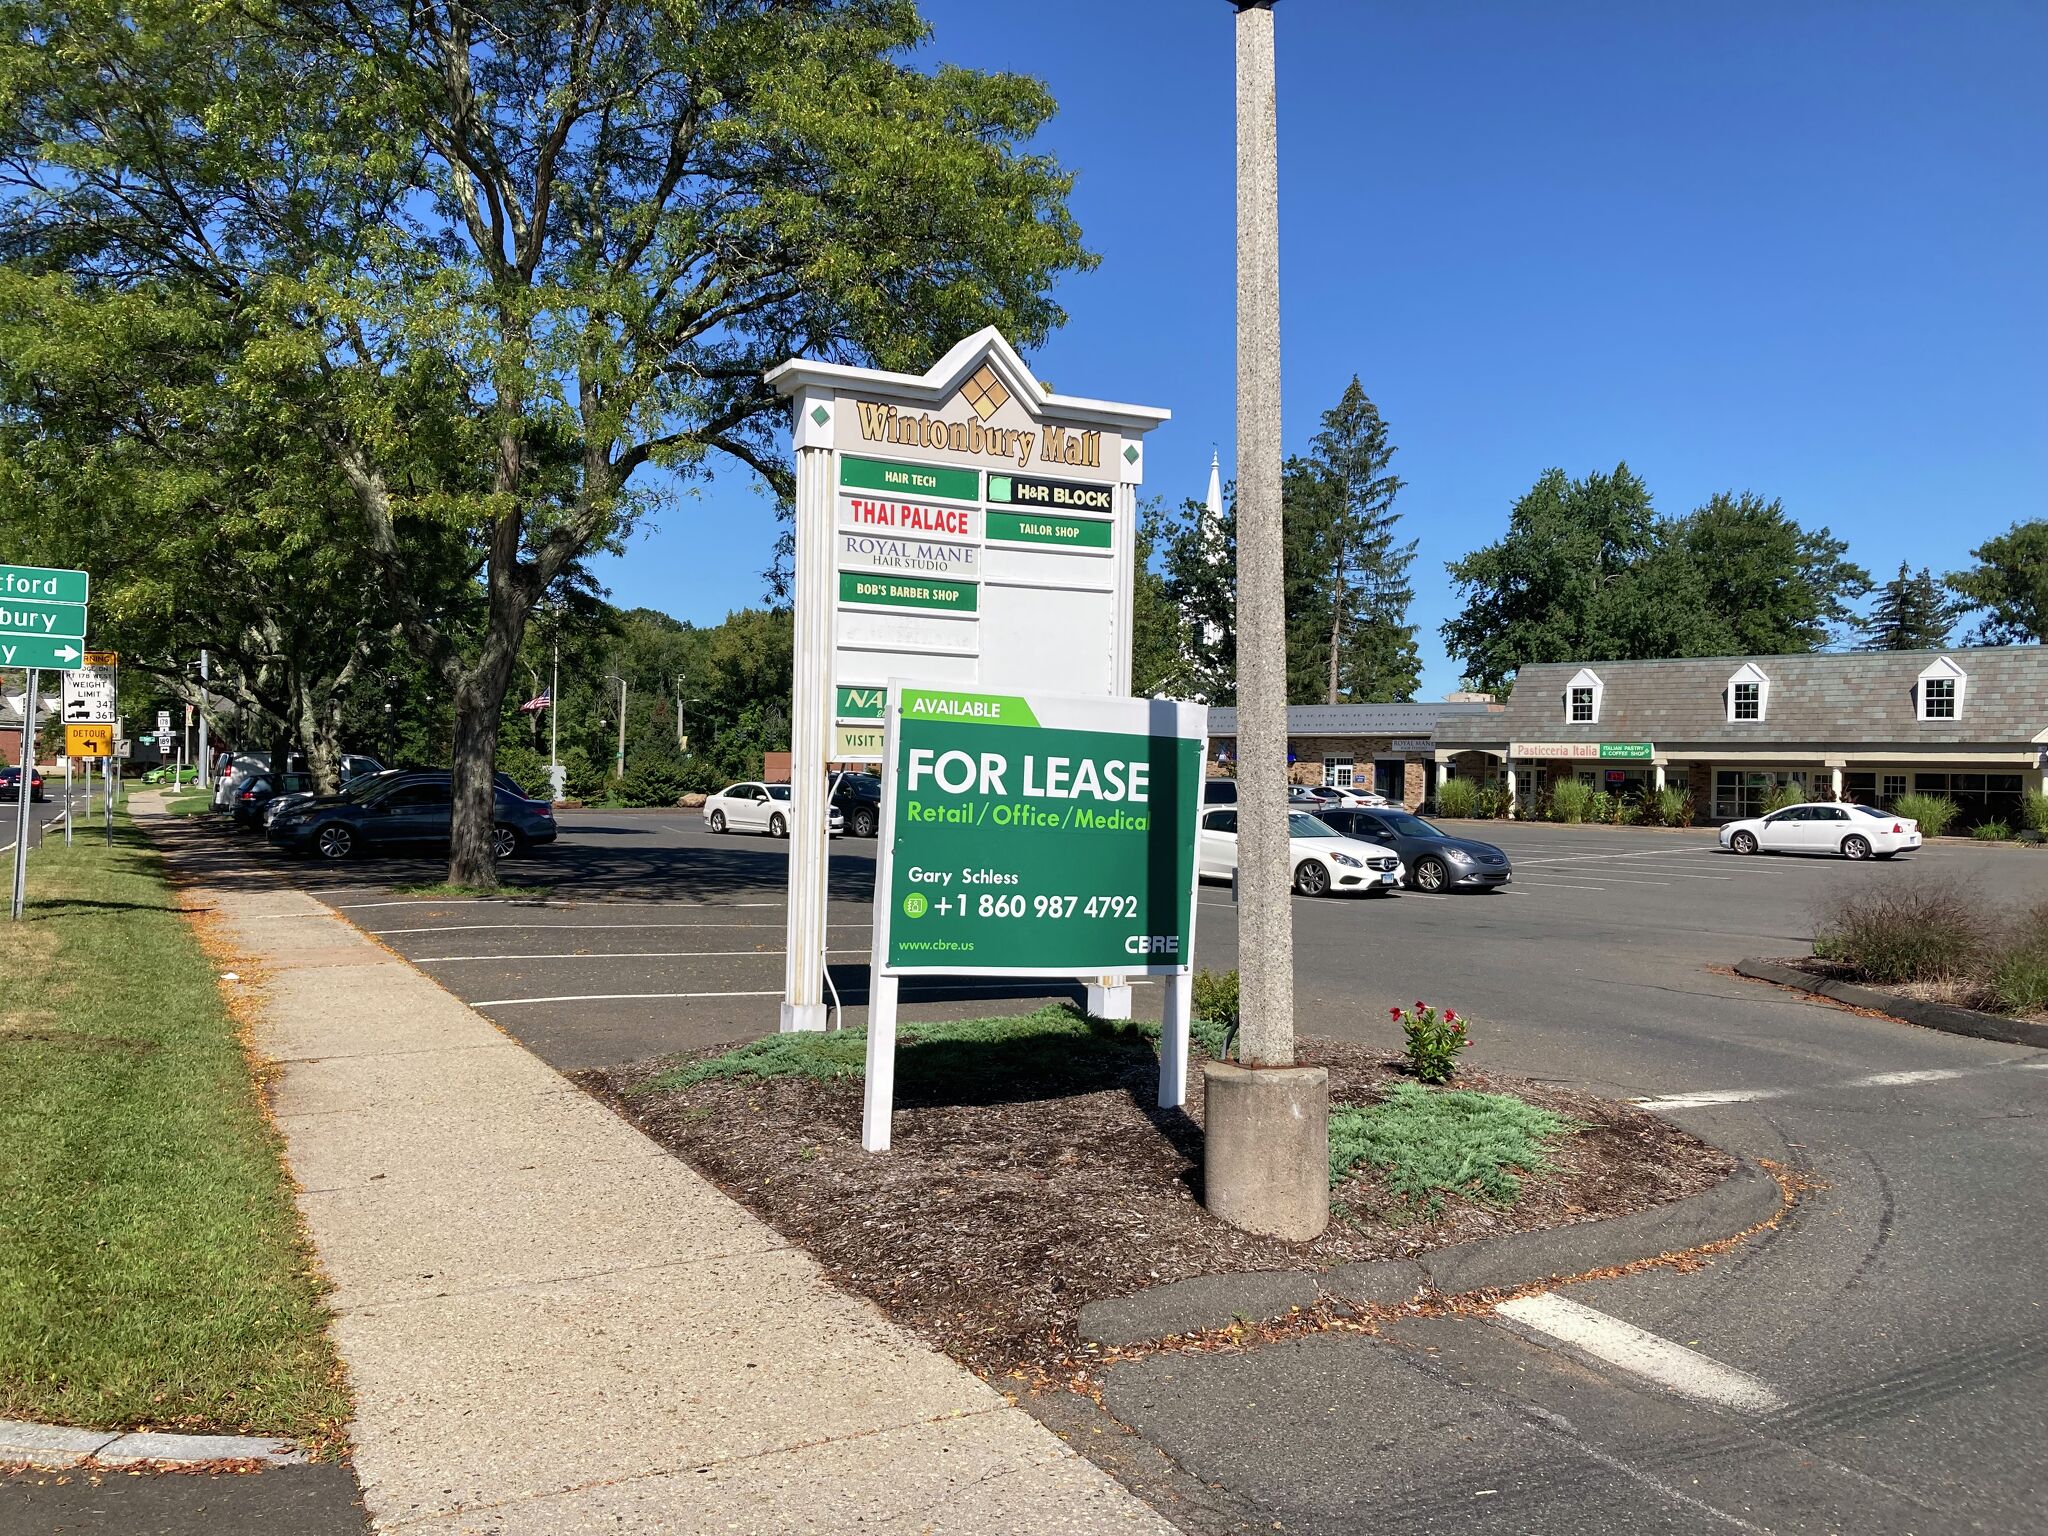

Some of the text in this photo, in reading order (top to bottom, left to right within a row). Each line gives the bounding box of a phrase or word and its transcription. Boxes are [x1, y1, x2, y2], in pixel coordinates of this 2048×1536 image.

[856, 401, 1101, 467] Wintonbury Mall
[885, 471, 936, 487] HAIR TECH
[1017, 483, 1110, 508] H&R BLOCK
[851, 501, 968, 534] THAI PALACE
[1019, 523, 1079, 538] TAILOR SHOP
[846, 538, 973, 564] ROYAL MANE
[873, 555, 948, 572] HAIR STUDIO
[857, 583, 959, 602] BOB'S BARBER SHOP
[0, 607, 57, 632] bury
[2, 645, 17, 664] y
[845, 689, 888, 708] NA
[913, 698, 1000, 718] AVAILABLE
[845, 734, 875, 746] VISIT
[1518, 745, 1597, 756] Pasticceria Italia
[907, 749, 1149, 802] FOR LEASE
[908, 867, 1019, 886] Gary Schless
[934, 894, 1137, 918] +1 860 987 4792
[899, 940, 974, 951] www.cbre.us
[1125, 936, 1179, 953] CBRE
